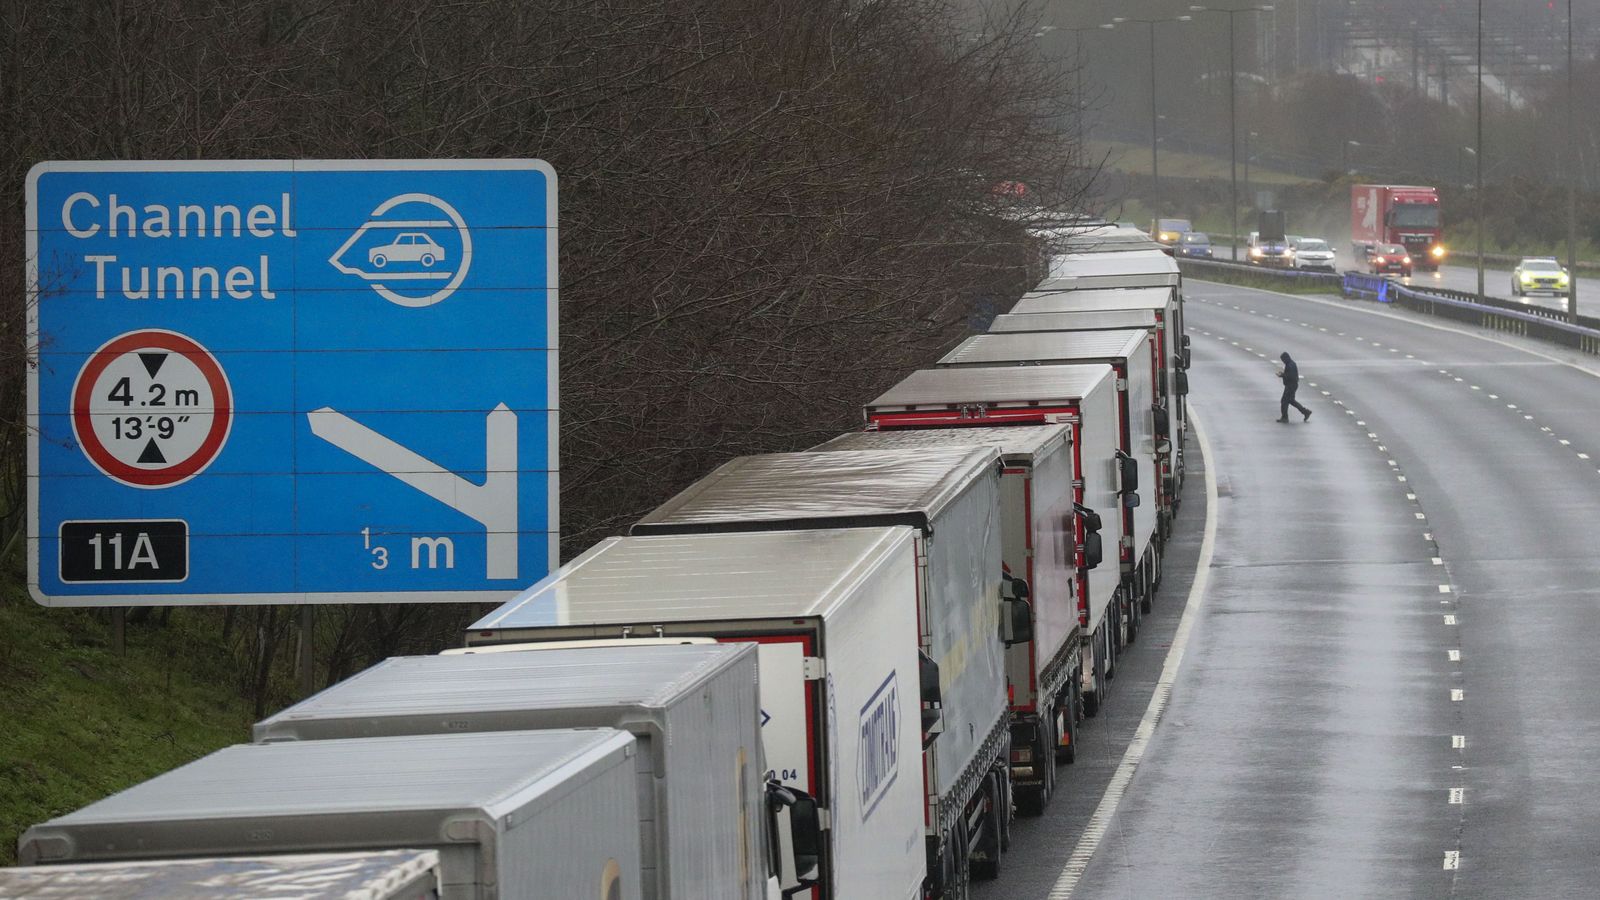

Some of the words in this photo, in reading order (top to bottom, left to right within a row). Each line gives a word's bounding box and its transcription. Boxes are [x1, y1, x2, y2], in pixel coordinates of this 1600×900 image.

[61, 191, 297, 239] Channel
[84, 255, 276, 300] Tunnel
[107, 376, 167, 407] 4.2
[175, 389, 199, 406] m
[88, 532, 160, 570] 11A
[411, 536, 454, 569] m
[782, 768, 798, 781] 04
